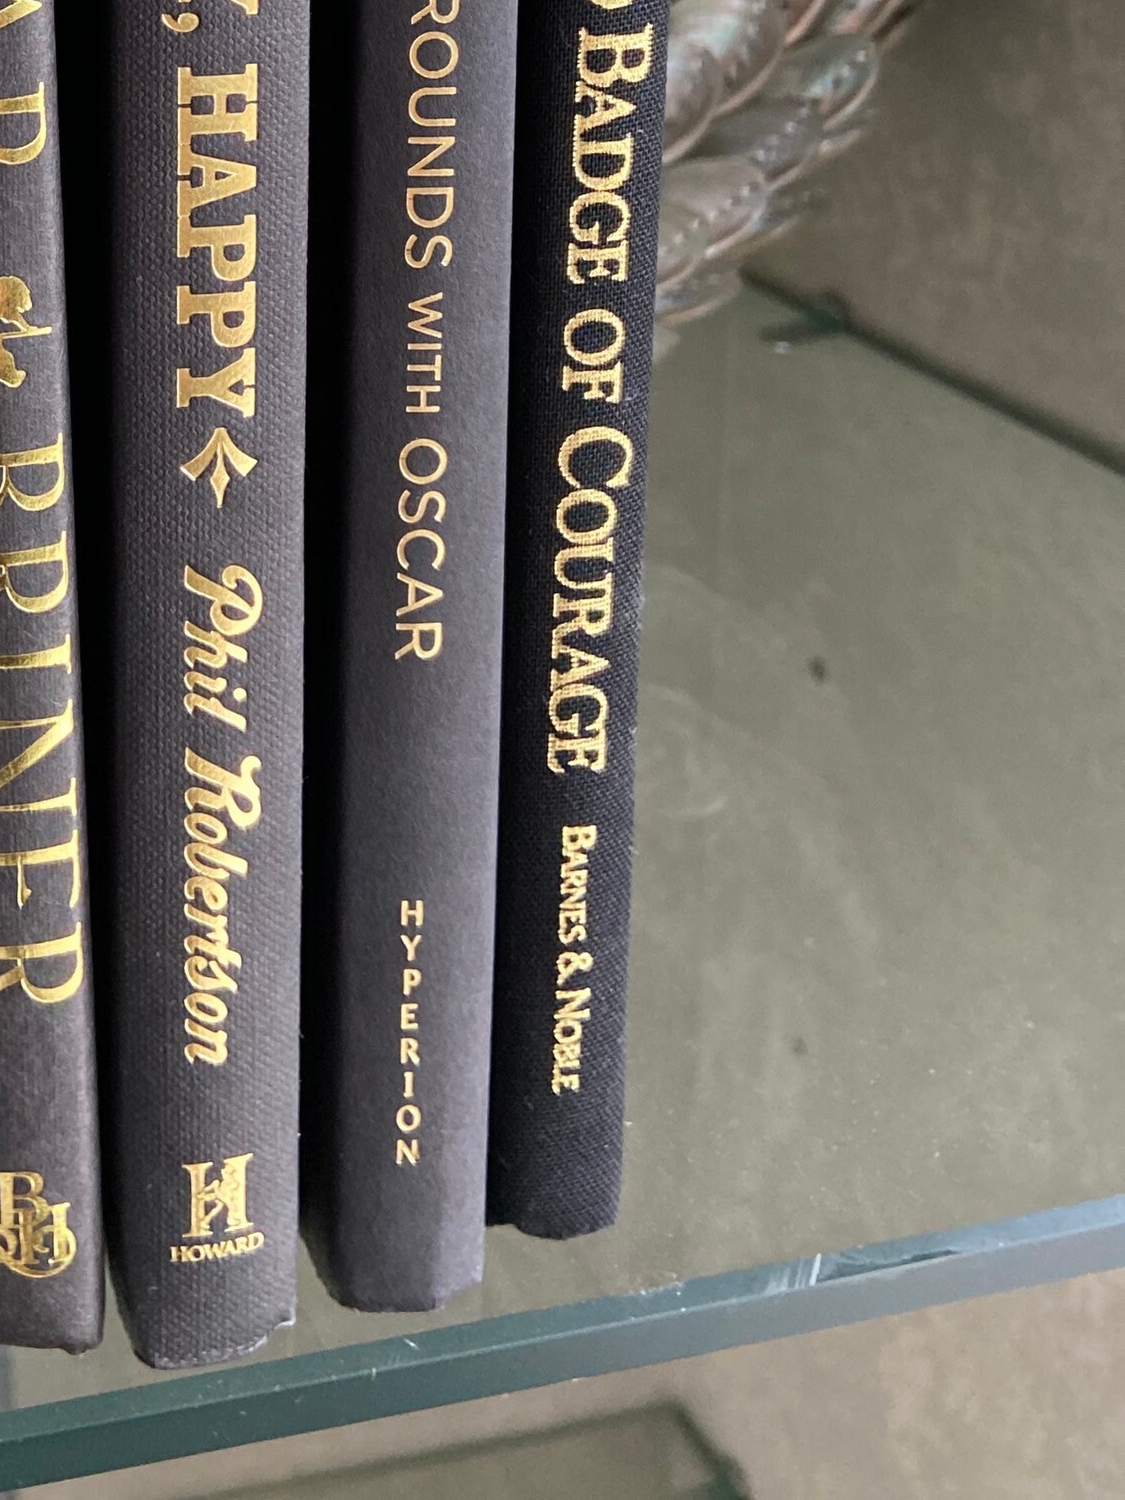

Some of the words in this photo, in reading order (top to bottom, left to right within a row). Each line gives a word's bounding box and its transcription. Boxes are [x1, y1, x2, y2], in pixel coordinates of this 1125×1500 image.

[567, 26, 653, 283] BADGE
[177, 64, 258, 418] HAPPY
[406, 293, 443, 415] WITH
[562, 309, 625, 402] OF
[396, 438, 448, 660] OSCAR
[547, 426, 632, 773] COURAGE
[183, 563, 264, 731] Phil
[183, 748, 262, 1065] Robertson
[556, 951, 591, 984] &
[557, 824, 597, 943] BARNES
[395, 900, 425, 1166] HYPERION
[551, 987, 590, 1094] NOBLE
[170, 1231, 265, 1263] HOWARD
